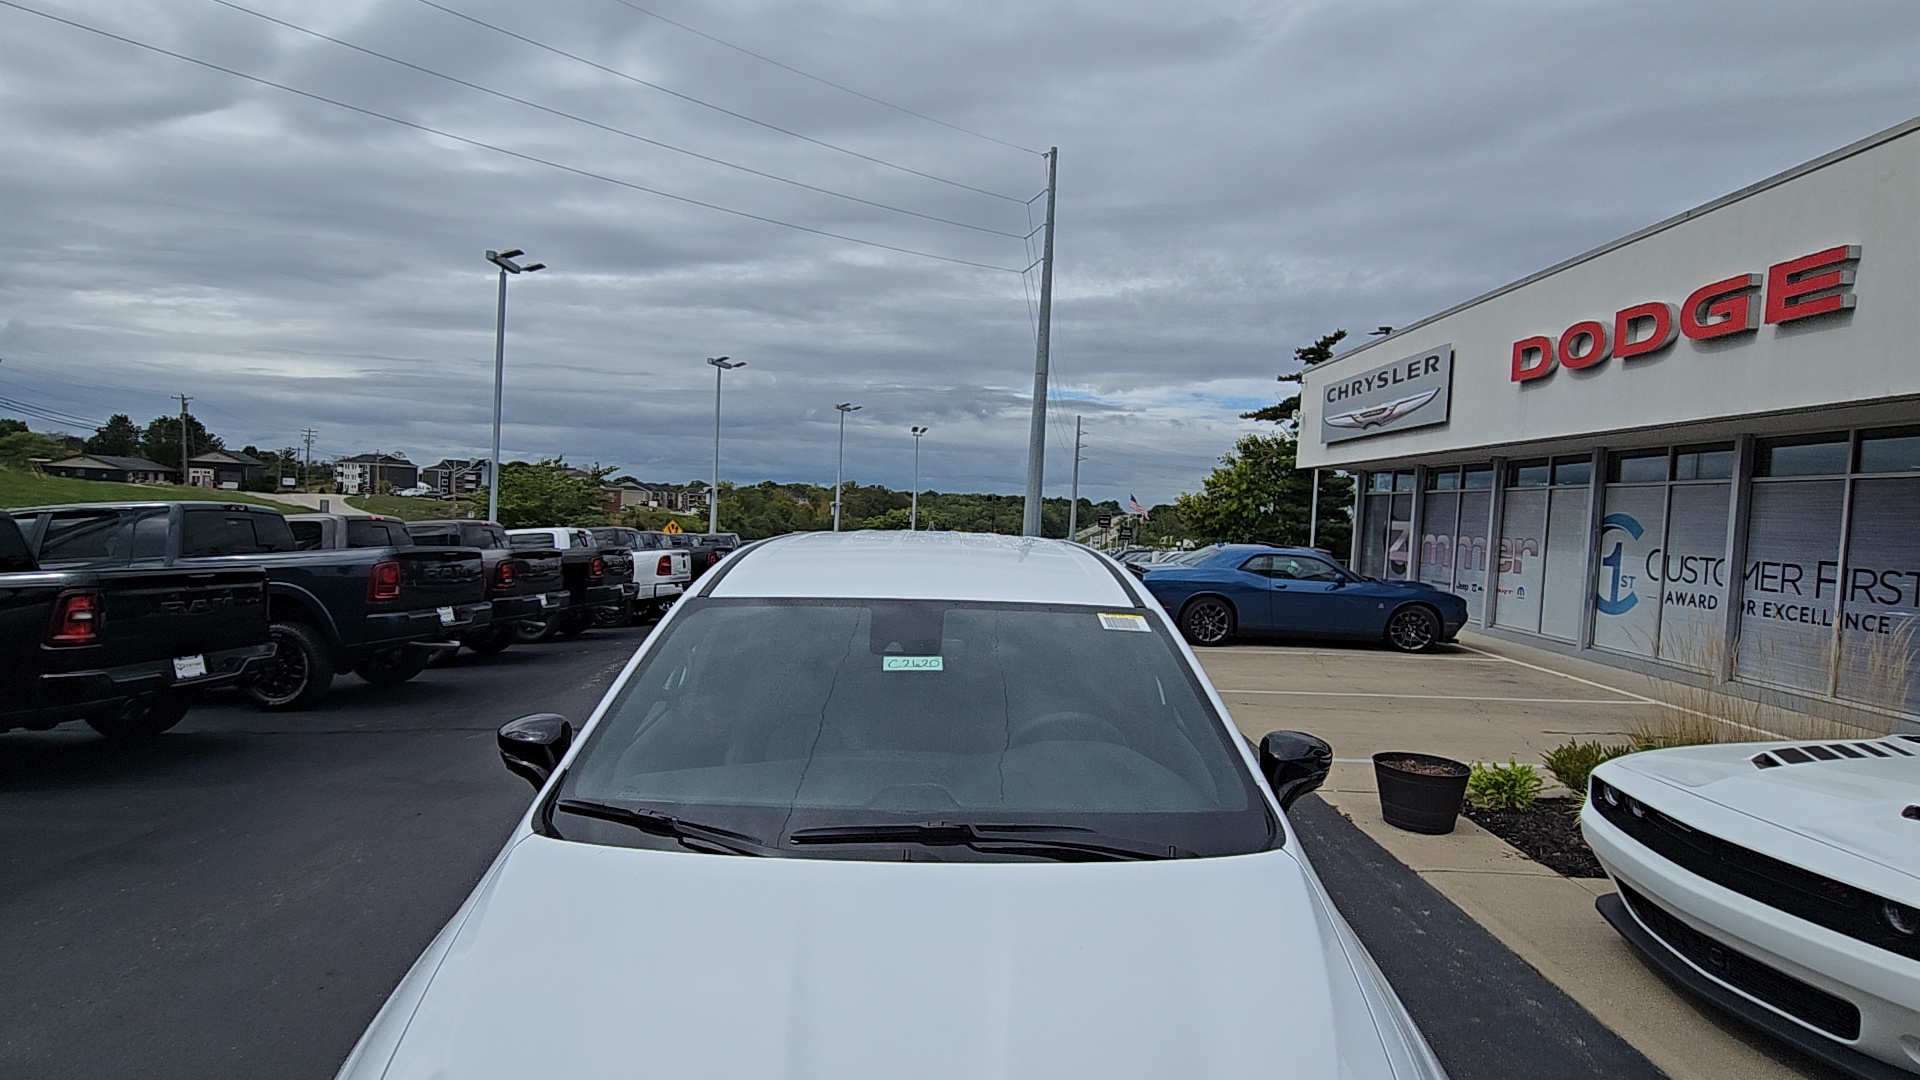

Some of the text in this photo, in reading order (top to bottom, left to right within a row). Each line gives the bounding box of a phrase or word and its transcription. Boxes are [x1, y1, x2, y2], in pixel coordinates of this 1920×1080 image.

[1511, 245, 1858, 381] DODGE
[1326, 354, 1440, 404] CHRYSLER
[1388, 519, 1539, 575] Zmmer
[1665, 590, 1718, 610] AWARD
[1763, 603, 1891, 635] EXCELLNCE
